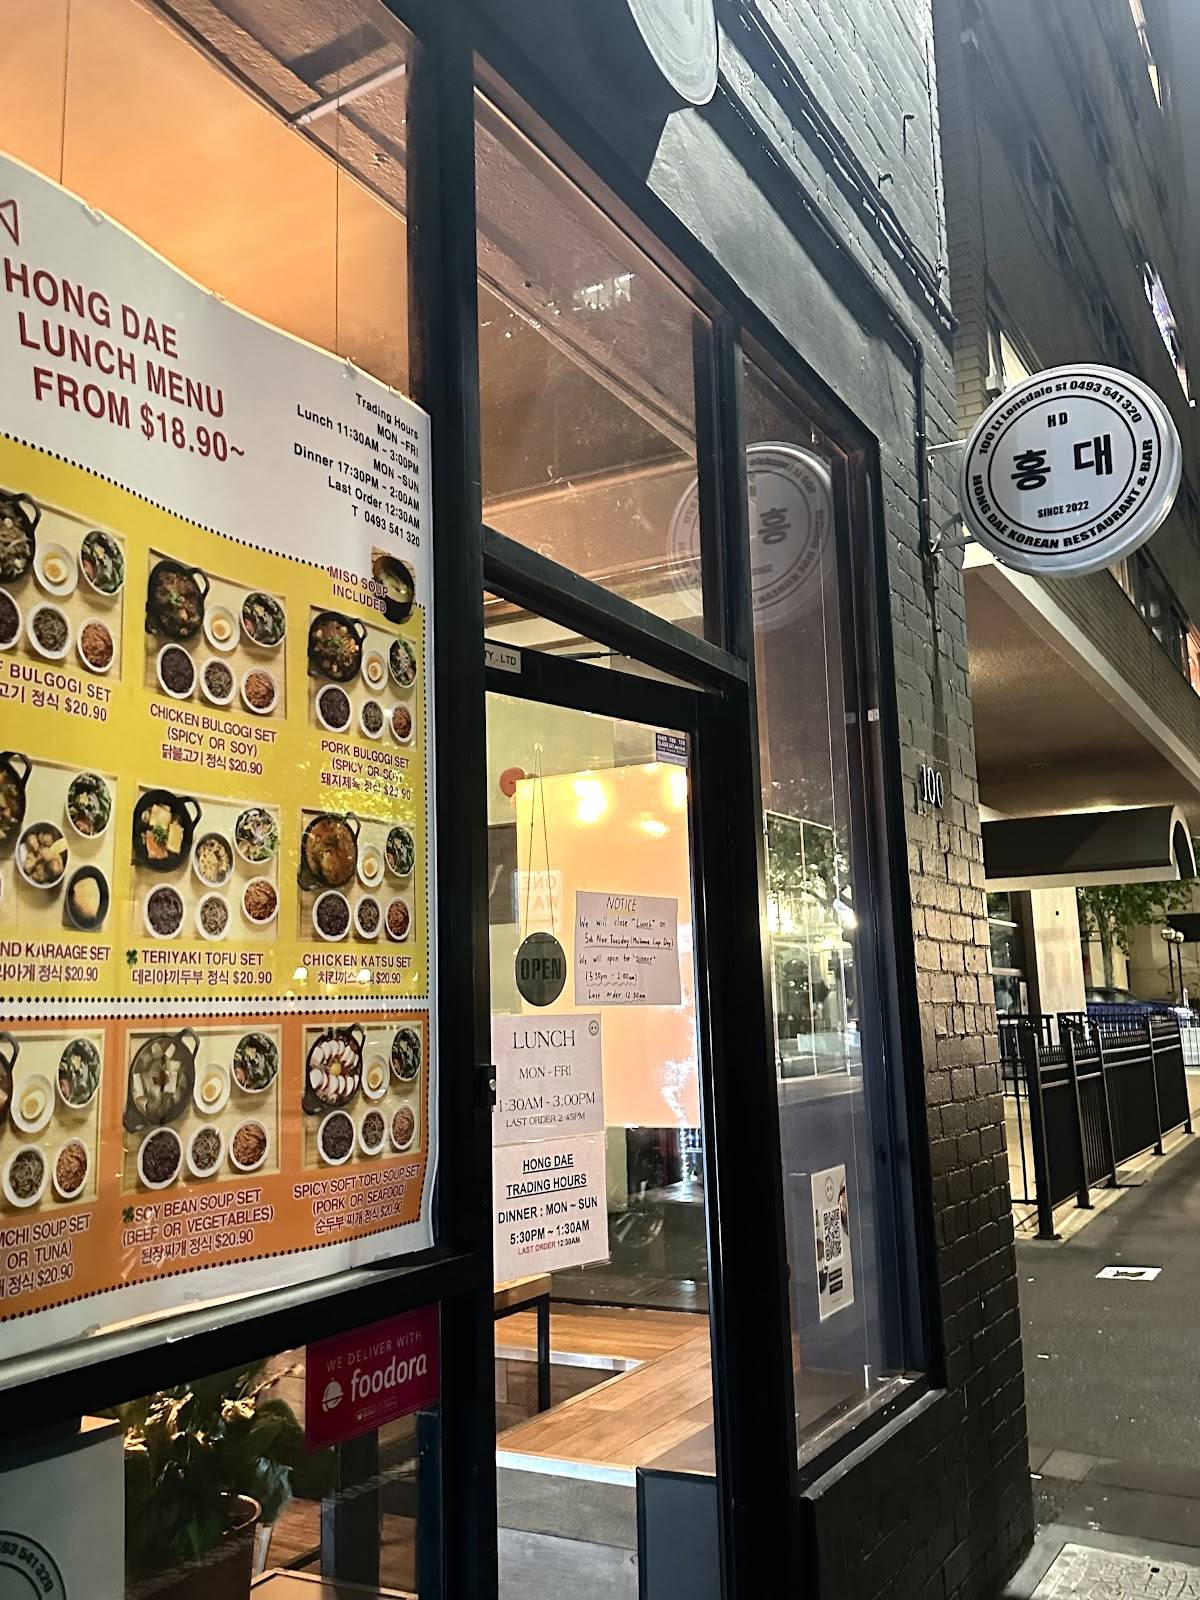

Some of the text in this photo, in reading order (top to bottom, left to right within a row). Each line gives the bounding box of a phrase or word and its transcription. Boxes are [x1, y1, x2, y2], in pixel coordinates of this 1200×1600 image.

[4, 257, 178, 359] HONG DAE
[19, 311, 224, 417] LUNCH MENU
[33, 366, 245, 462] FROM $18.90~
[355, 392, 419, 440] Trading Hours
[979, 432, 995, 456] 100
[1002, 385, 1053, 419] Lonsdale
[1055, 382, 1068, 391] st
[1069, 380, 1102, 393] 0493
[1102, 384, 1125, 405] 541
[1121, 398, 1143, 424] 320
[297, 404, 420, 476] Lunch 11:30AM 3:00PM
[377, 423, 404, 446] MON
[294, 442, 420, 512] Dinner 17:30PM 2:00AM
[373, 458, 395, 481] MON
[328, 475, 420, 531] Last Order 12:30AM
[972, 439, 1154, 549] HONG DAE KOREAN RESTAURANT & BAR
[1037, 501, 1089, 518] SINCE 2022
[352, 505, 420, 548] T 0493 541 320
[329, 565, 389, 598] MISO SOUP
[333, 583, 387, 613] INCLUDED
[10, 663, 112, 702] BULGOGI SET
[32, 689, 59, 711] 정식
[64, 697, 107, 722] $20.90
[150, 703, 277, 743] CHICKEN BULGOGI SET
[167, 726, 258, 758] (SPICY OR SOY)
[321, 740, 410, 769] PORK BULGOGI SET
[206, 753, 227, 770] 정식
[229, 758, 263, 775] $20.90
[332, 757, 380, 777] (SPICY OR
[921, 764, 944, 809] 100
[606, 897, 637, 912] NOTICE
[25, 942, 88, 960] KARAAGE
[89, 946, 111, 961] SET
[142, 950, 264, 966] TERIYAKI TOFU SET
[302, 954, 412, 968] CHICKEN KATSU SET
[38, 964, 98, 983] 정식 $20.90
[207, 970, 229, 986] 정식
[233, 971, 272, 985] $20.90
[376, 971, 401, 984] $20.90
[521, 958, 561, 980] OPEN
[513, 1029, 575, 1049] LUNCH
[519, 1065, 572, 1079] MON FRI
[552, 1091, 595, 1107] 3:00PM
[505, 1118, 527, 1128] LAST
[528, 1114, 556, 1125] ORDER
[523, 1153, 574, 1172] HONG DAE
[294, 1164, 420, 1199] SPICY SOFT TOFU SOUP SET
[506, 1173, 587, 1197] TRADING HOURS
[135, 1188, 262, 1222] SOY BEAN SOUP SET
[312, 1197, 345, 1215] (PORK
[350, 1194, 364, 1207] OR
[498, 1196, 598, 1224] DINNER MON SUN
[32, 1214, 91, 1241] SOUP SET
[122, 1206, 274, 1246] (BEEF OR VEGETABLES)
[510, 1219, 590, 1245] 5:30PM 1:30AM
[7, 1240, 72, 1270] OR TUNA)
[188, 1235, 212, 1255] 정식
[215, 1229, 253, 1249] $20.90
[518, 1236, 581, 1255] LAST ORDER 12:30AM
[9, 1263, 74, 1295] 정식 $20.90
[326, 1330, 422, 1372] WE DELIVER WITH
[351, 1354, 428, 1402] foodora
[36, 1563, 54, 1593] 320
